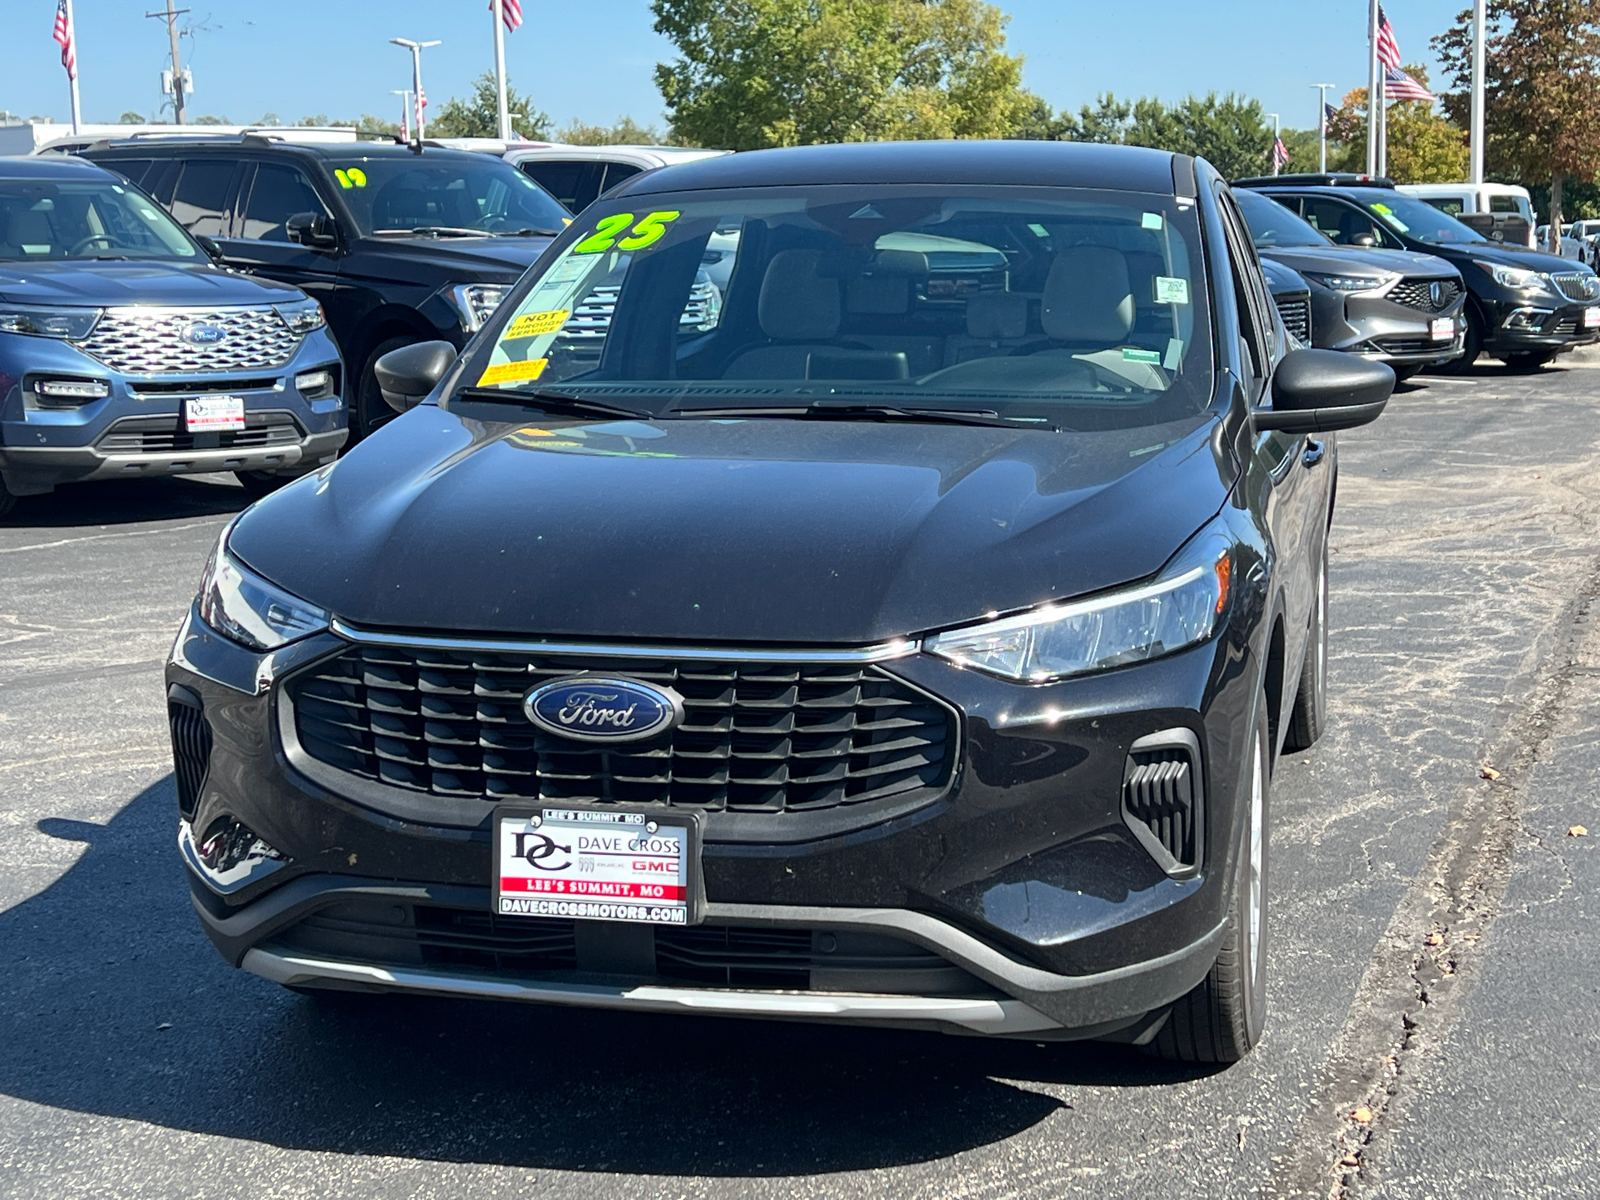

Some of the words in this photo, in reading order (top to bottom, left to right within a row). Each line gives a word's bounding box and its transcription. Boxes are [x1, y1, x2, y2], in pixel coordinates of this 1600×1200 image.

[334, 167, 367, 189] 19
[573, 210, 681, 253] 25
[511, 319, 564, 331] THROUGH
[524, 312, 559, 323] NOT
[508, 326, 555, 337] SERVICE
[509, 360, 543, 369] VEHICLE
[558, 691, 638, 727] Ford
[545, 810, 575, 820] LEE'S
[577, 812, 620, 822] SUMMIT
[624, 814, 643, 824] MO
[511, 832, 573, 871] DC
[578, 836, 622, 851] DAVE
[628, 838, 681, 854] CROSS
[632, 860, 680, 873] GMC
[527, 879, 565, 891] LEE'S
[569, 880, 635, 897] SUMMIT,
[640, 885, 664, 897] MO
[502, 899, 685, 922] DAVECROSSMOTORS.COM
